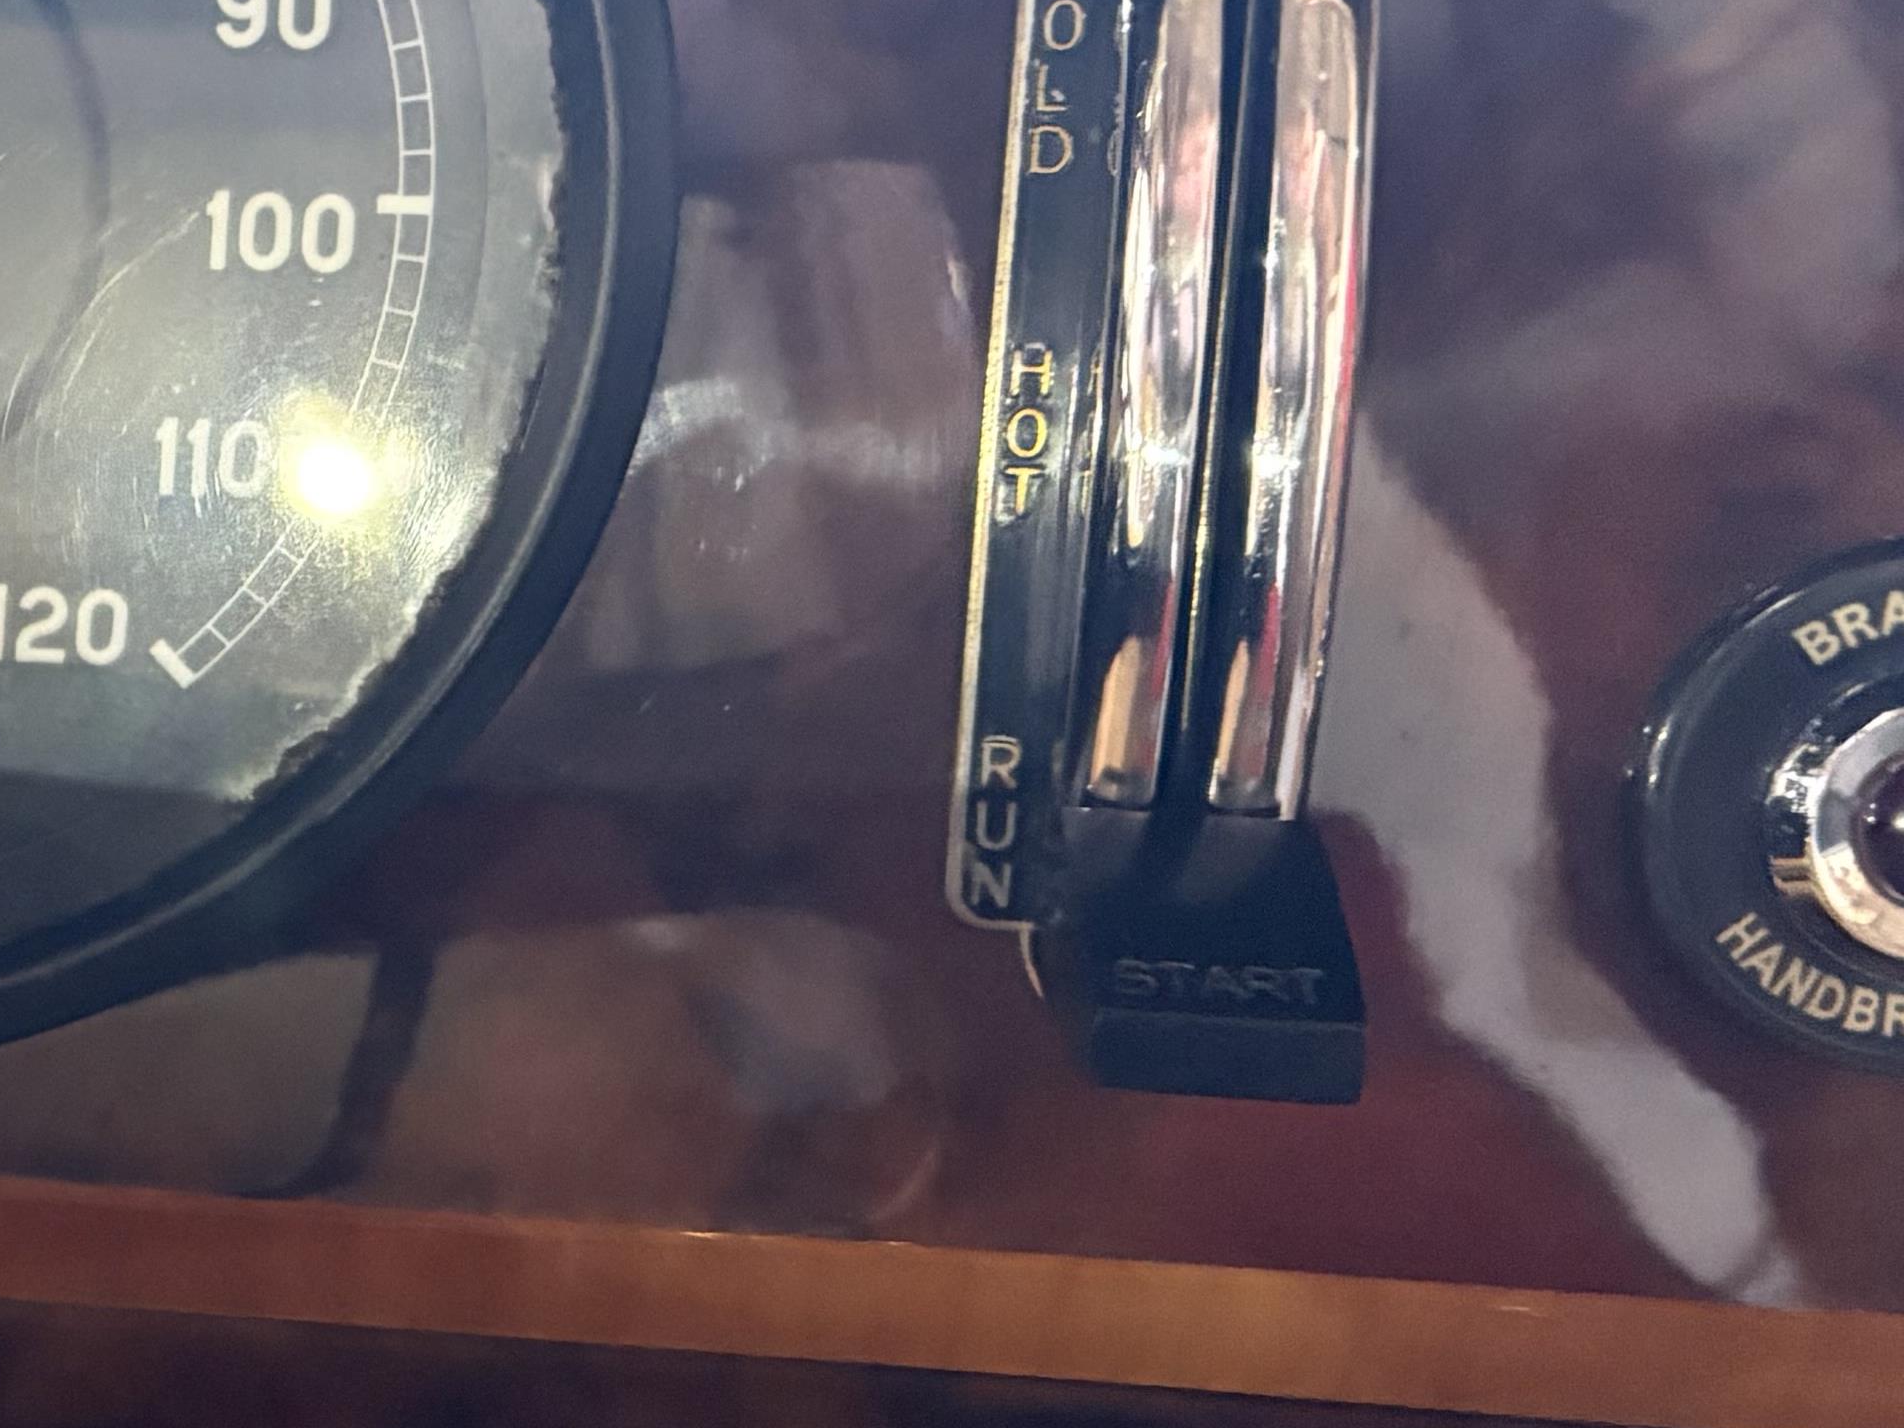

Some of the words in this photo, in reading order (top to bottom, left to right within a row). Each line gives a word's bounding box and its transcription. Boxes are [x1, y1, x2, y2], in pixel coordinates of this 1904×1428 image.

[205, 189, 356, 274] 100
[156, 415, 274, 499] 110
[1116, 958, 1324, 1006] START
